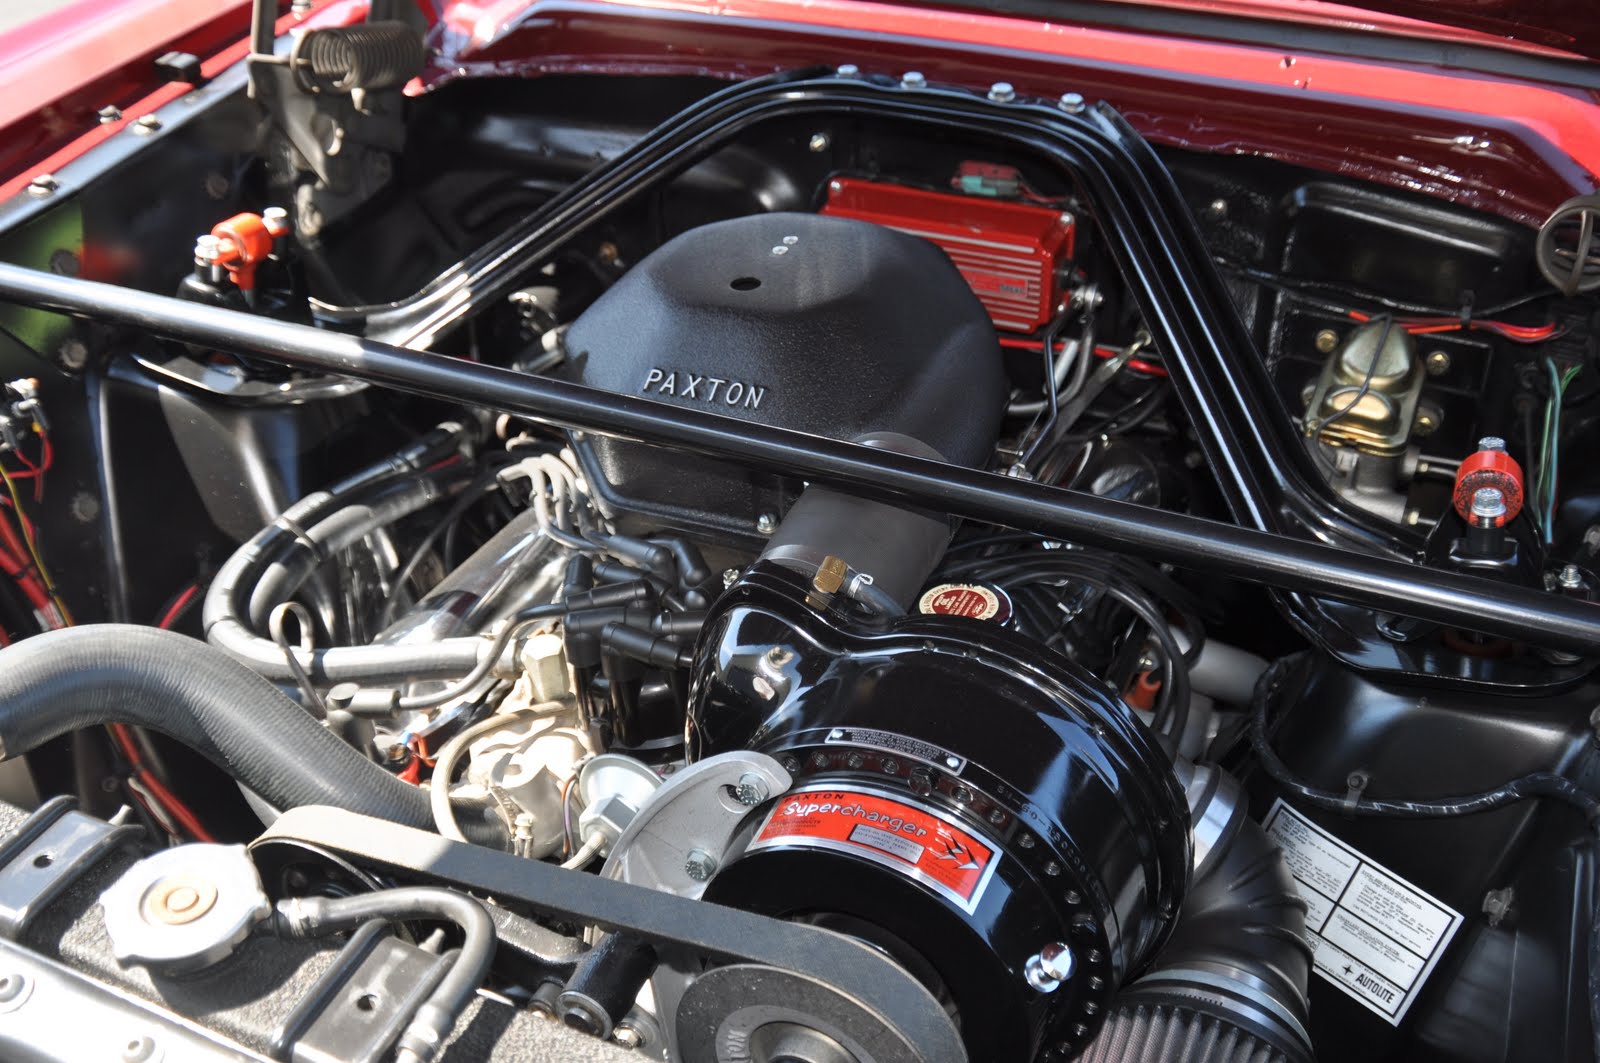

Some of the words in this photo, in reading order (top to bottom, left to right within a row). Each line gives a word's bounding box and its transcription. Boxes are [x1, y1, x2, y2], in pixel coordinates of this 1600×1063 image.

[643, 369, 765, 409] PAXTON
[784, 792, 845, 803] PAXTON
[784, 801, 928, 838] Supercharger
[1355, 973, 1395, 1004] AUTOLITE
